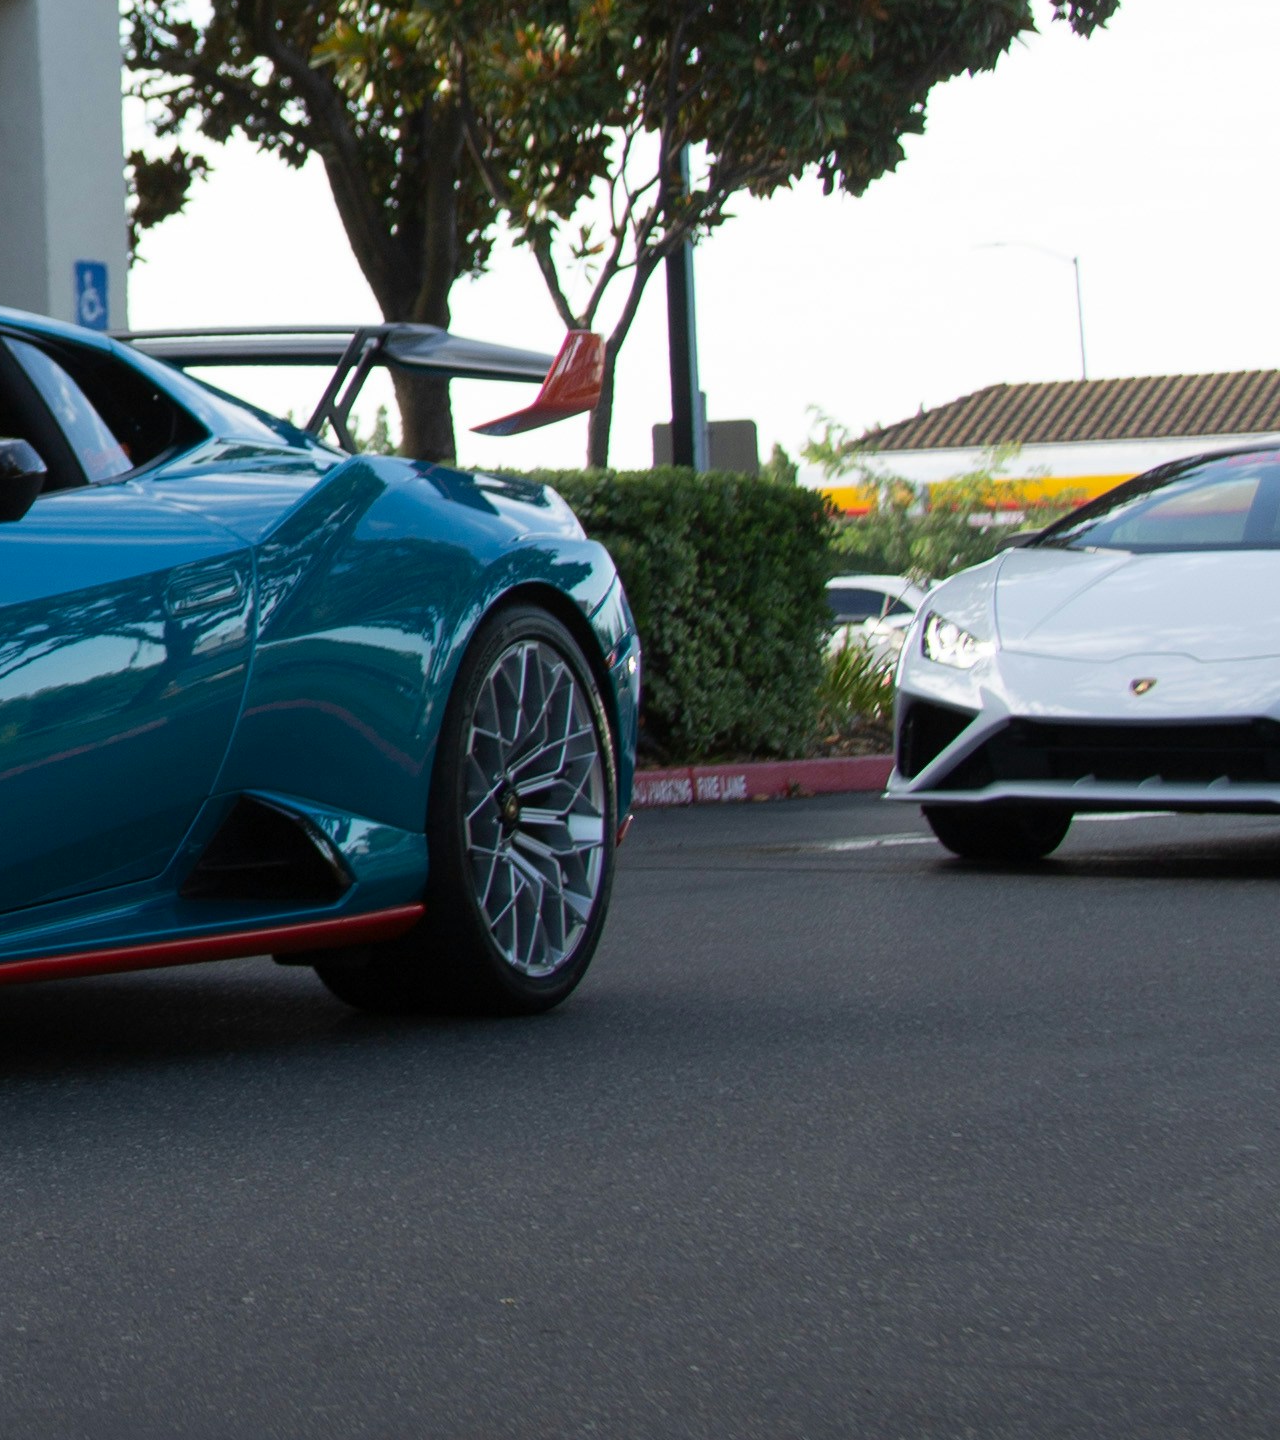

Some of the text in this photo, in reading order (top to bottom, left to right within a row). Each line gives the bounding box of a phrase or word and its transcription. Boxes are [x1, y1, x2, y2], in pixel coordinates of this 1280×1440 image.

[648, 778, 692, 805] PARKING
[697, 775, 720, 801] FIRE
[721, 774, 747, 802] LANE
